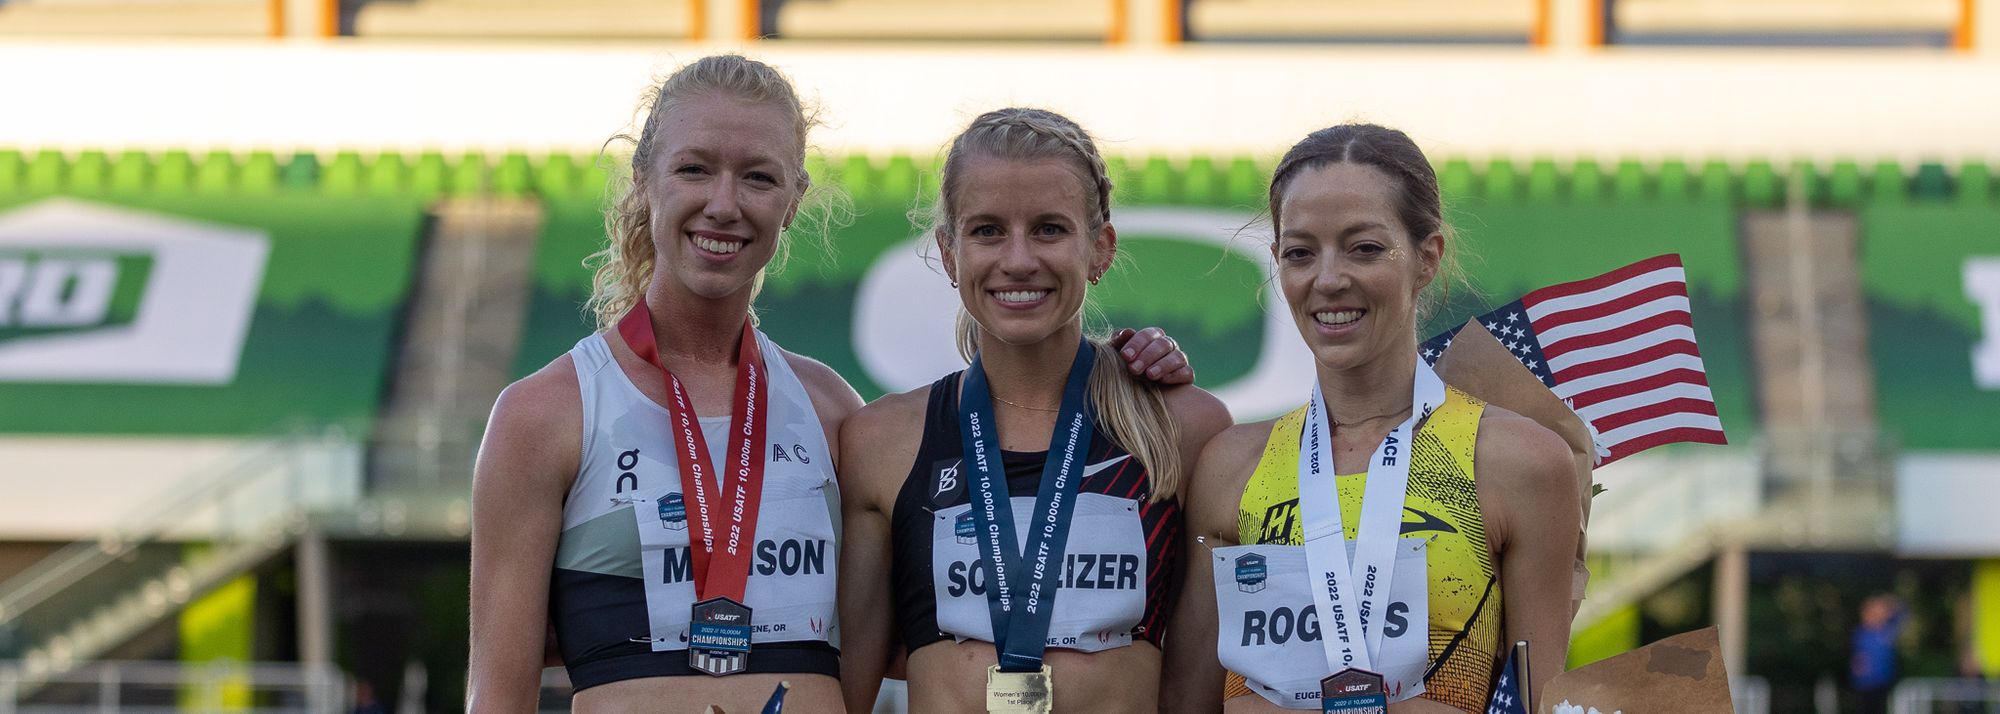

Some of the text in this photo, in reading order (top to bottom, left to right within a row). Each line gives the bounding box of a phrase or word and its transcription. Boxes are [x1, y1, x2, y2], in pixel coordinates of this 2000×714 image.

[1311, 422, 1319, 450] USATF
[738, 438, 752, 482] 10,000m
[1311, 451, 1320, 475] 2022
[680, 412, 697, 460] 10,000m
[692, 463, 714, 553] Championships
[732, 485, 747, 523] USATF
[970, 411, 1011, 612] 2022 USATF 10,000m Championships
[1027, 412, 1083, 615] 2022 USATF 10,000m Championships
[727, 525, 740, 556] 2022
[663, 538, 826, 584] MSON
[947, 553, 1139, 598] SCIZER
[1325, 571, 1340, 602] 2022
[1363, 564, 1378, 597] 2022
[714, 613, 738, 621] USATF
[773, 624, 786, 632] OR
[1240, 602, 1410, 647] ROGS
[1332, 604, 1350, 643] USATF
[692, 634, 748, 647] CHAMPIONSHIPS
[1062, 637, 1076, 645] OR
[1295, 691, 1321, 700] EUGE
[1345, 684, 1370, 692] USATF
